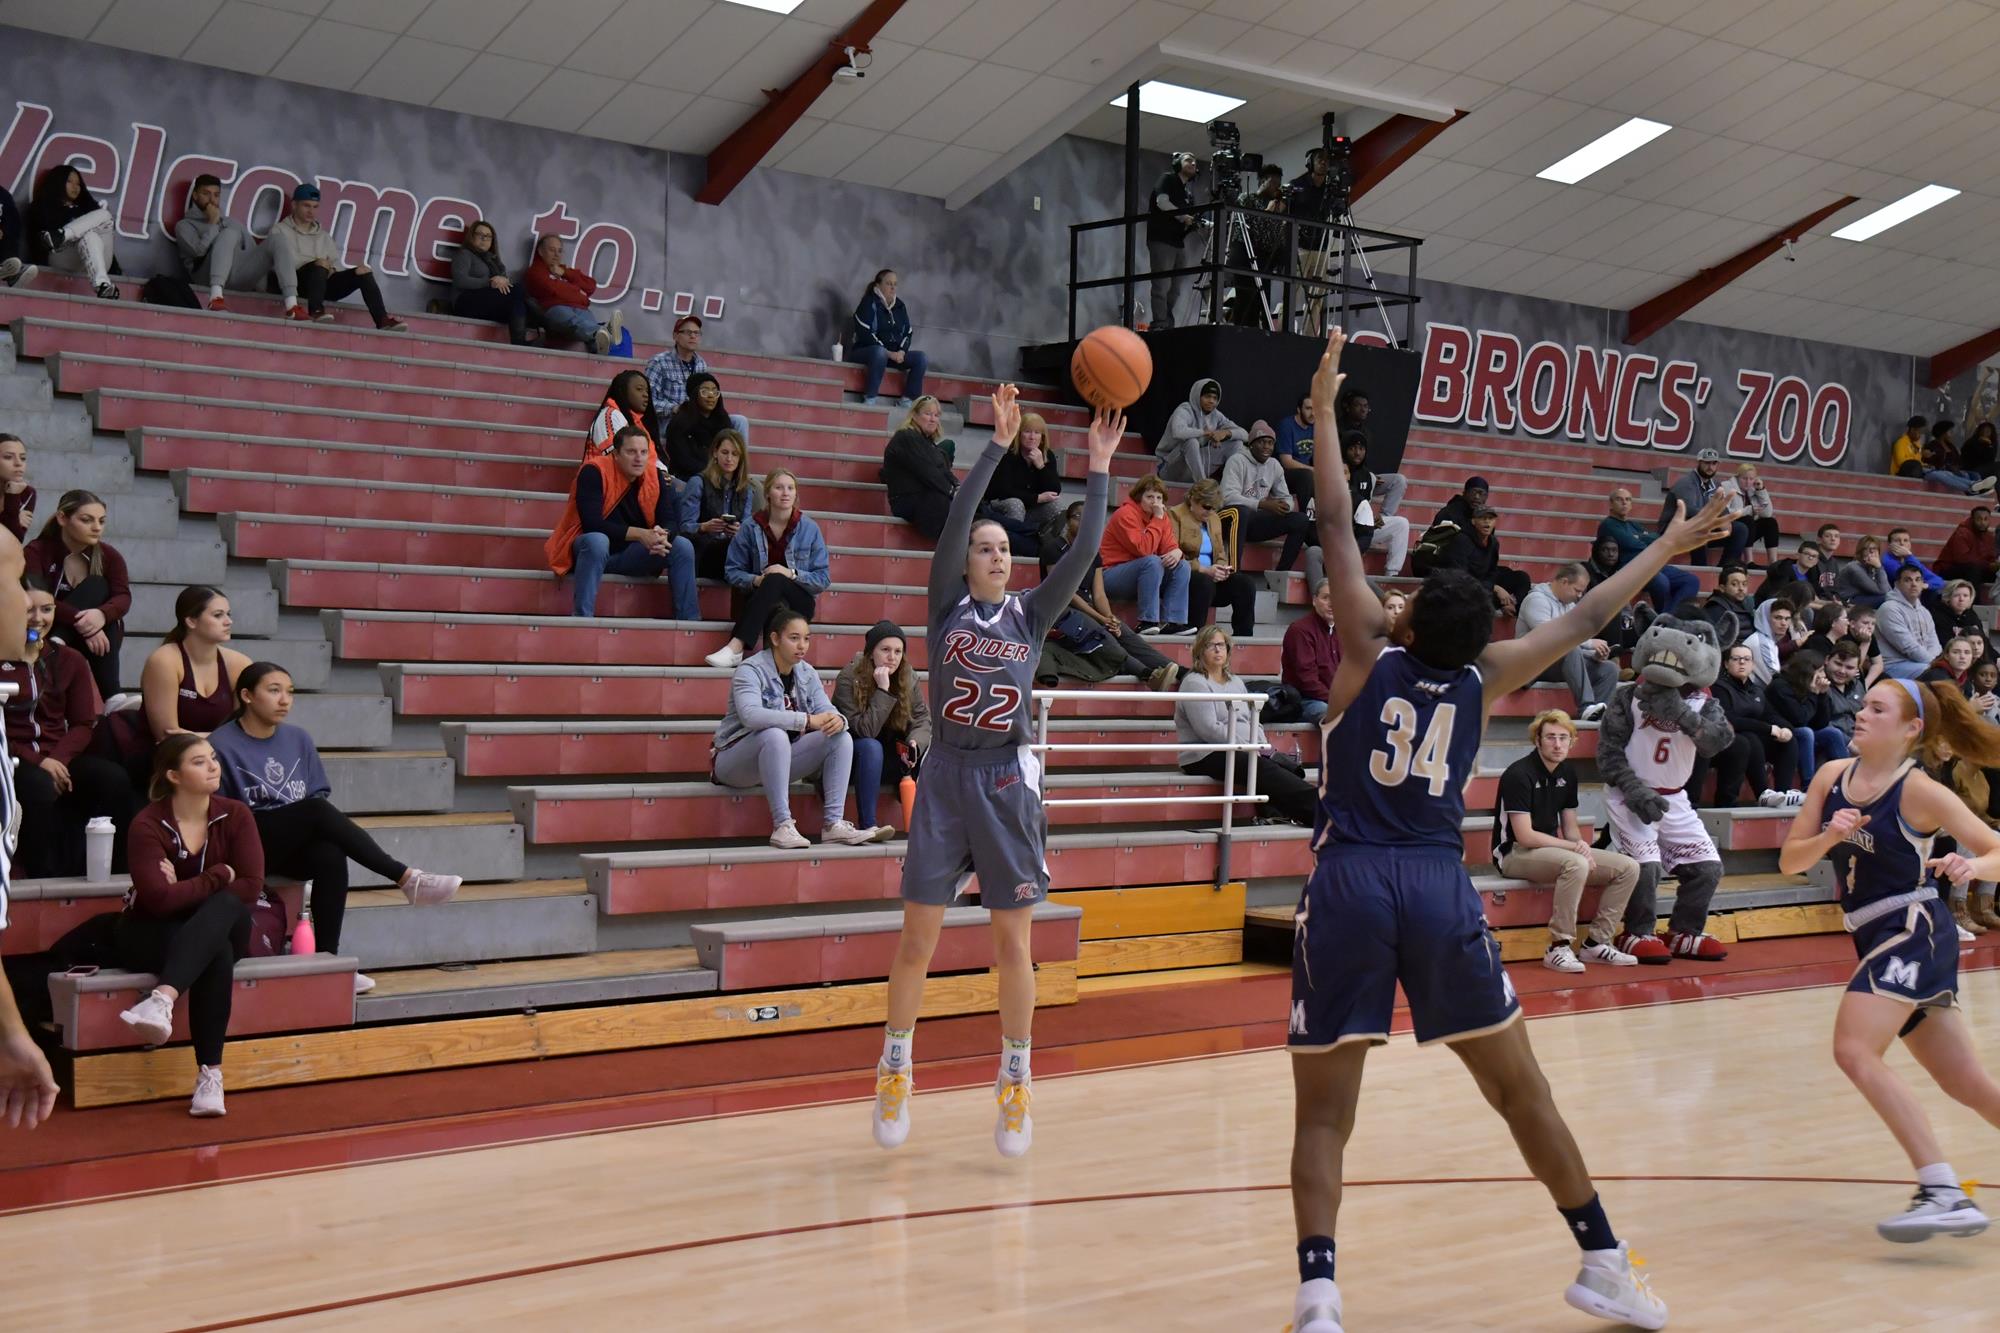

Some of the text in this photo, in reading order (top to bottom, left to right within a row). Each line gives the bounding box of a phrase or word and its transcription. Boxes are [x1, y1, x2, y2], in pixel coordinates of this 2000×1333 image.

[1414, 322, 1712, 450] BRONCS'
[1726, 368, 1852, 467] ZOO
[943, 629, 1030, 673] RIDER
[942, 676, 1021, 732] 22
[1368, 696, 1457, 798] 34
[1653, 736, 1672, 765] 6
[1879, 954, 1922, 991] M
[1288, 999, 1309, 1035] M
